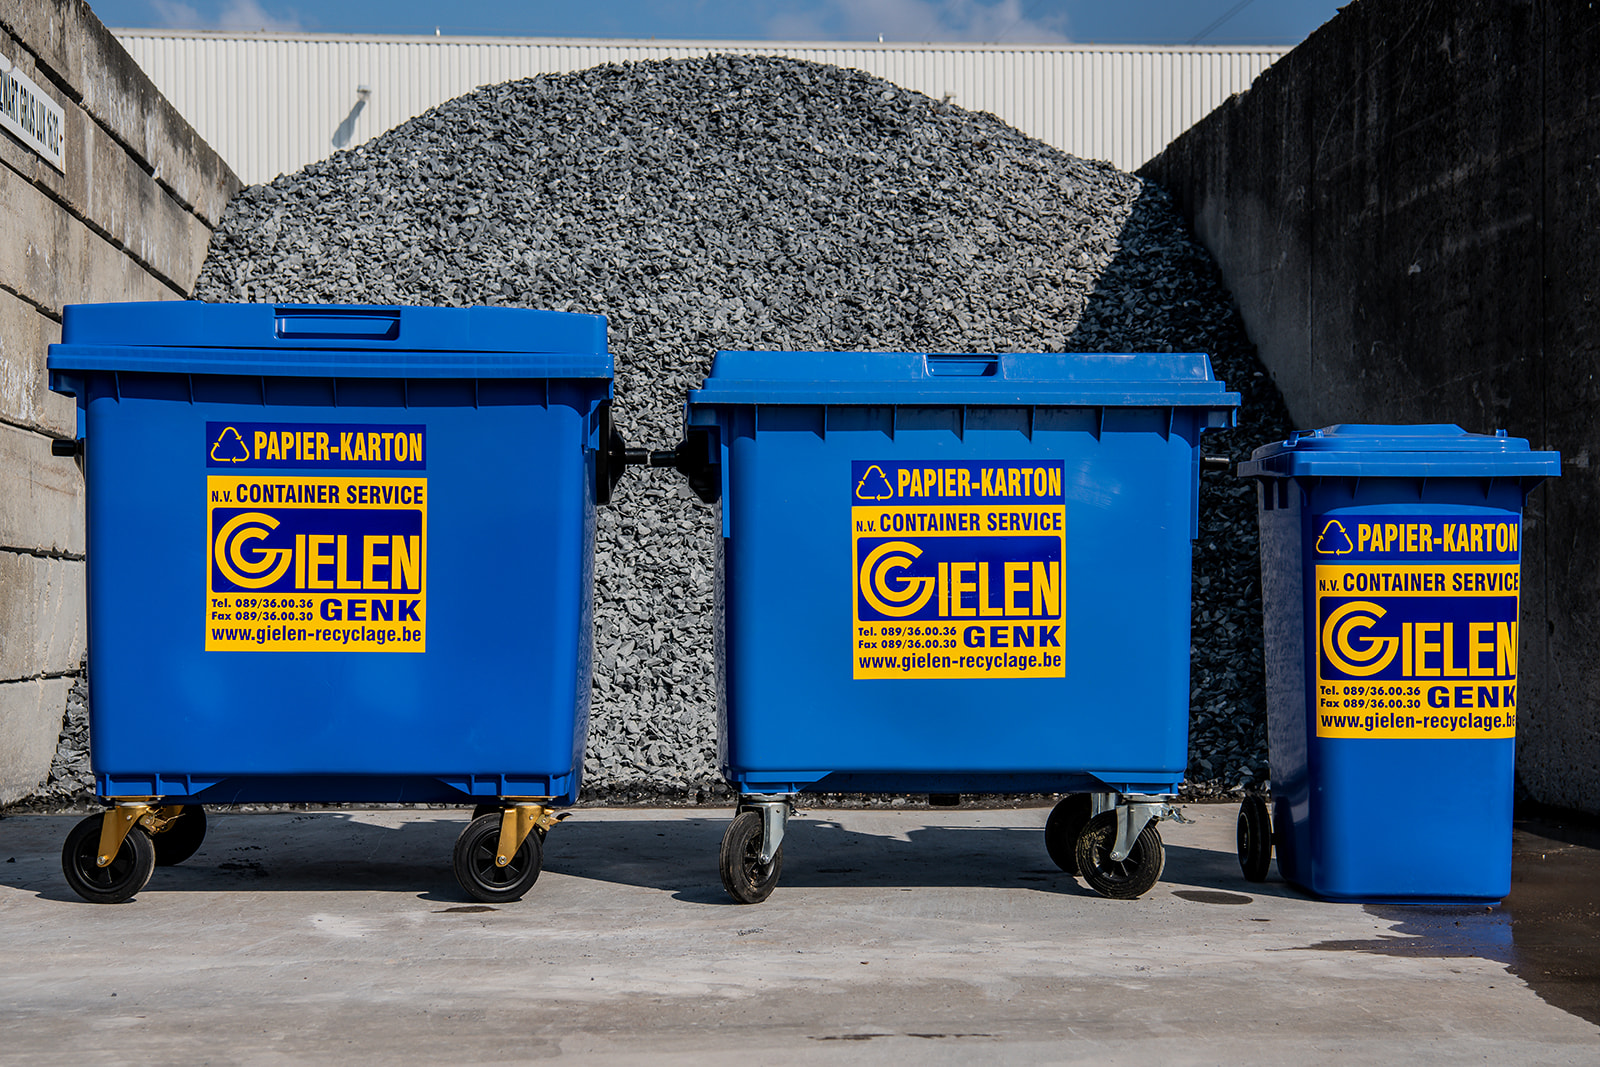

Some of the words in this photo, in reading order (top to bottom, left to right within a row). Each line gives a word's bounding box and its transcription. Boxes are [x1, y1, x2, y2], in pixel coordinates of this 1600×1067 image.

[254, 431, 422, 462] PAPIER-KARTON
[898, 468, 1061, 497] PAPIER-KARTON
[212, 491, 232, 502] N.V.
[236, 484, 339, 503] CONTAINER
[347, 485, 423, 504] SERVICE
[856, 521, 876, 532] N.V.
[880, 513, 980, 532] CONTAINER
[987, 512, 1061, 531] SERVICE
[1358, 523, 1518, 552] PAPIER-KARTON
[215, 512, 420, 589] GIELEN
[860, 541, 1059, 617] GIELEN
[1319, 580, 1339, 591] N.V.
[1343, 573, 1445, 592] CONTAINER
[1452, 572, 1518, 591] SERVICE
[212, 599, 231, 608] Tel.
[235, 599, 313, 609] 089/36.00.36
[320, 599, 421, 621] GENK
[212, 612, 231, 621] Fax
[235, 612, 313, 621] 089/36.00.30
[212, 625, 421, 644] www.gielen-recyclage.be
[858, 627, 877, 636] Tel.
[881, 627, 957, 637] 089/36.00.36
[963, 626, 1061, 648] GENK
[1322, 601, 1516, 676] GIELEN
[881, 639, 957, 649] 089/36.00.30
[859, 652, 1061, 671] www.gielen-recyclage.be
[1320, 686, 1339, 695] Tel.
[1343, 686, 1420, 696] 089/36.00.36
[1427, 685, 1515, 708] GENK
[1320, 699, 1339, 708] Fax
[1343, 699, 1420, 709] 089/36.00.30
